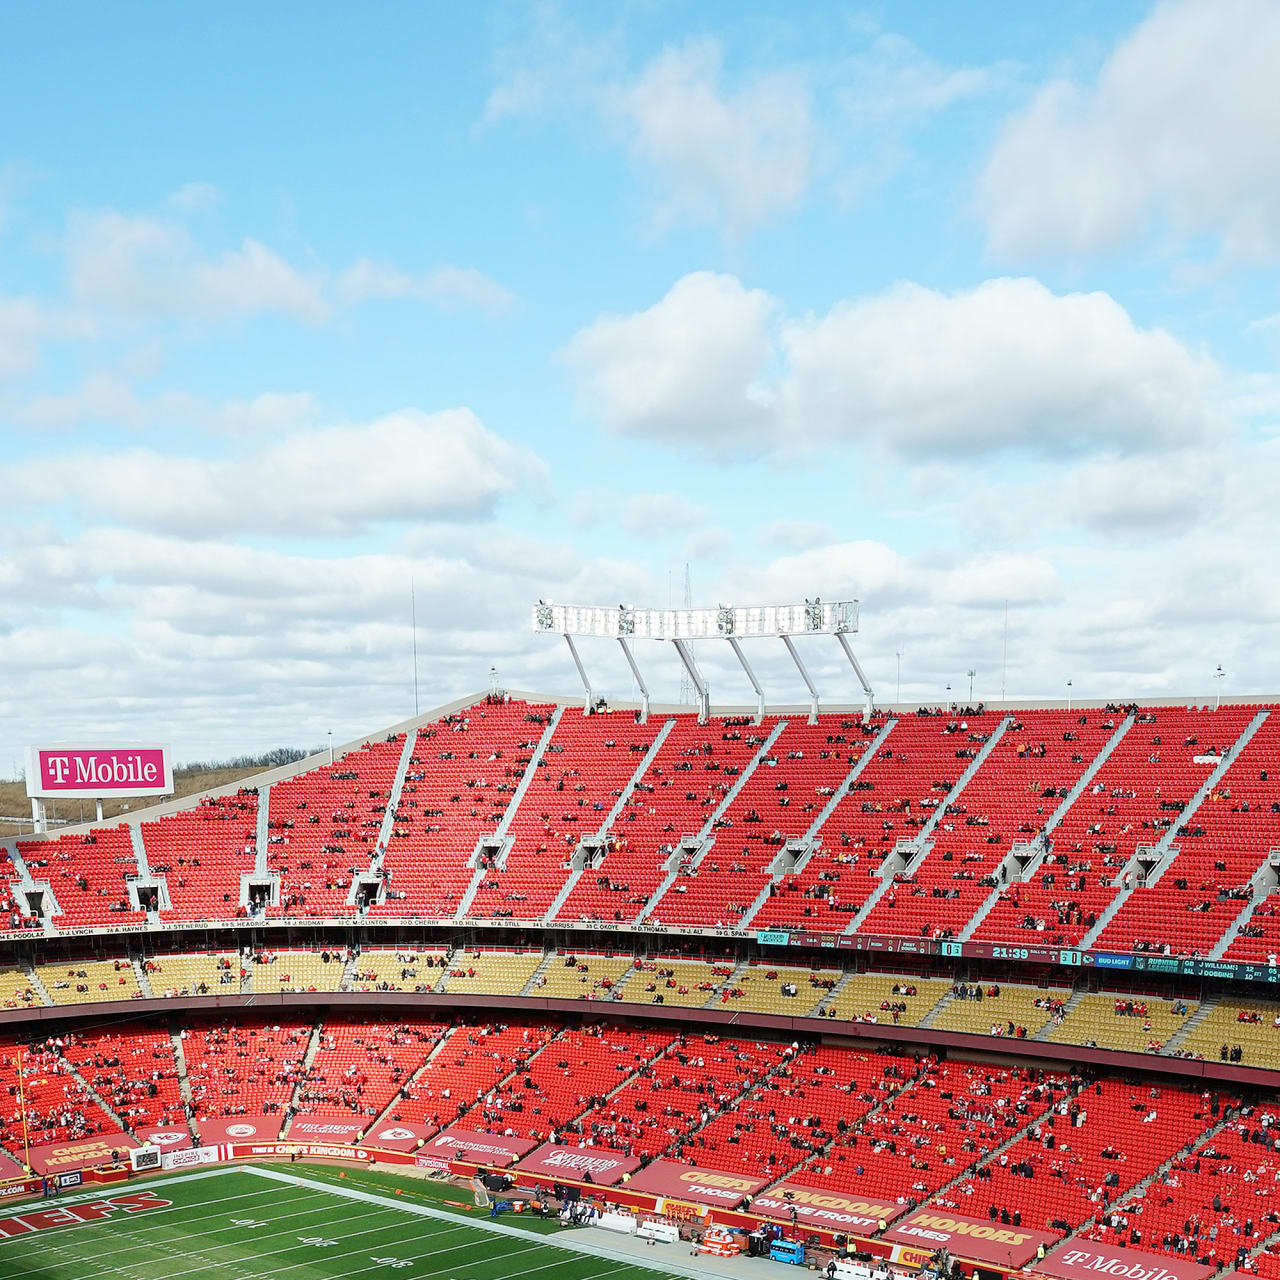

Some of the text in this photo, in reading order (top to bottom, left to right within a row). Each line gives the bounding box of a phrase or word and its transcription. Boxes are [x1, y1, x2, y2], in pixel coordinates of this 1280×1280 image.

[48, 756, 157, 783] T Mobile
[13, 932, 45, 940] PODOLAK
[992, 947, 1028, 960] 21:39
[44, 1145, 130, 1166] KINGDOM
[51, 1141, 109, 1156] CHIEFS
[310, 1145, 355, 1158] KINGDOM
[548, 1149, 624, 1169] Community
[679, 1171, 760, 1191] CHIEFS
[687, 1185, 743, 1199] THOSE
[766, 1187, 894, 1217] KINGDOM
[754, 1198, 780, 1209] ON
[816, 1209, 879, 1227] FRONT
[897, 1226, 951, 1242] LINES
[910, 1214, 1032, 1246] HONORS
[1063, 1249, 1089, 1266] T
